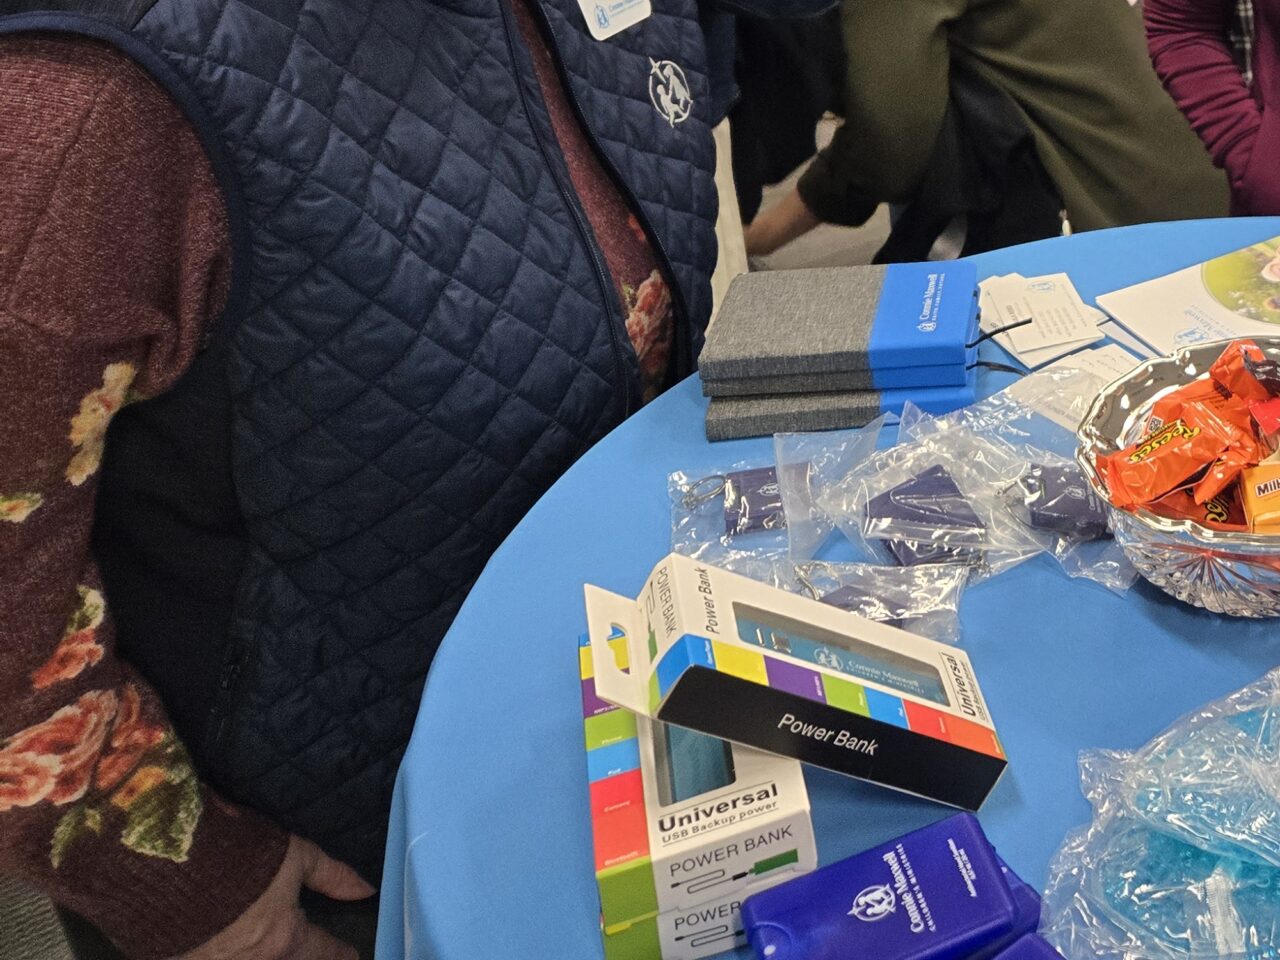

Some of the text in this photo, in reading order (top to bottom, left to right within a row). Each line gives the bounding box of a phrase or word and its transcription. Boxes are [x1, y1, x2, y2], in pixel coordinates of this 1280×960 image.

[920, 297, 933, 320] Connie
[657, 566, 678, 638] POWER BANK
[694, 567, 712, 595] Bank
[704, 597, 720, 635] Power
[942, 651, 976, 718] Universal
[777, 713, 879, 757] Power Bank
[657, 783, 778, 832] Universal
[661, 800, 778, 844] USB Backup power
[669, 824, 794, 877] POWER BANK
[882, 851, 925, 934] Connie Maxwell
[674, 900, 741, 930] POWER
